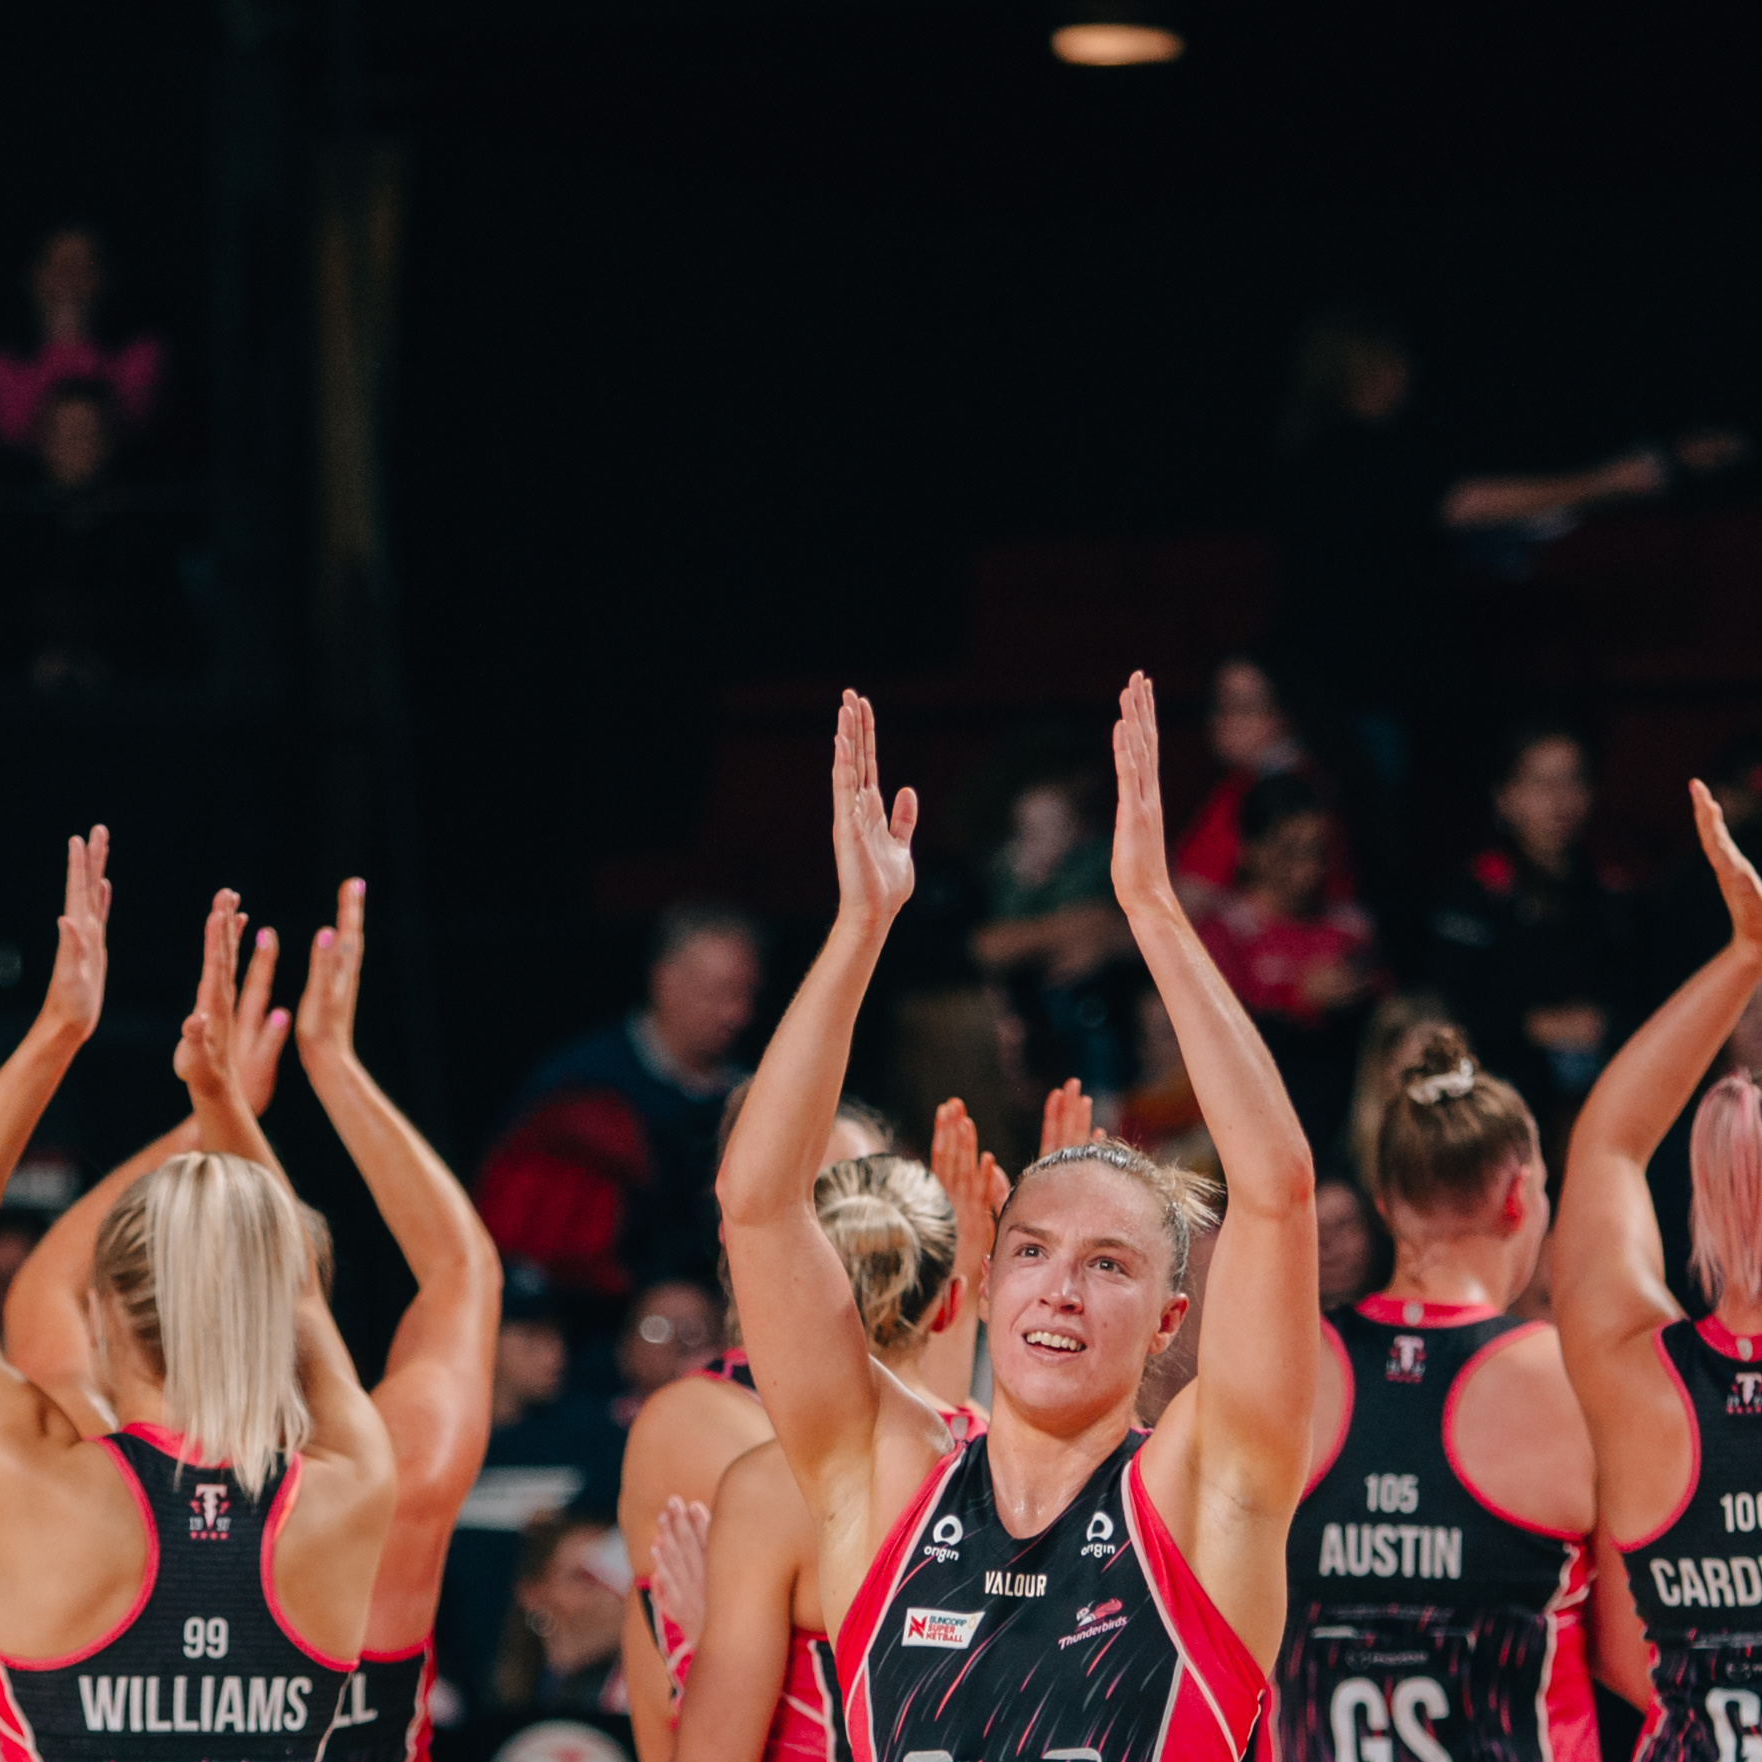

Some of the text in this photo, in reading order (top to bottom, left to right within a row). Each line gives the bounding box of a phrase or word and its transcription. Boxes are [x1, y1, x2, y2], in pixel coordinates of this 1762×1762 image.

[1365, 1473, 1419, 1514] 105
[924, 1545, 959, 1563] origin
[1081, 1543, 1115, 1558] origin
[1319, 1523, 1463, 1579] AUSTIN
[984, 1571, 1047, 1597] VALOUR
[928, 1623, 956, 1634] SUPER
[929, 1615, 967, 1627] SUNCORP
[1057, 1616, 1128, 1651] Thunderbirds
[183, 1617, 229, 1659] 99
[926, 1633, 963, 1643] NETBALL
[78, 1675, 313, 1732] WILLIAMS
